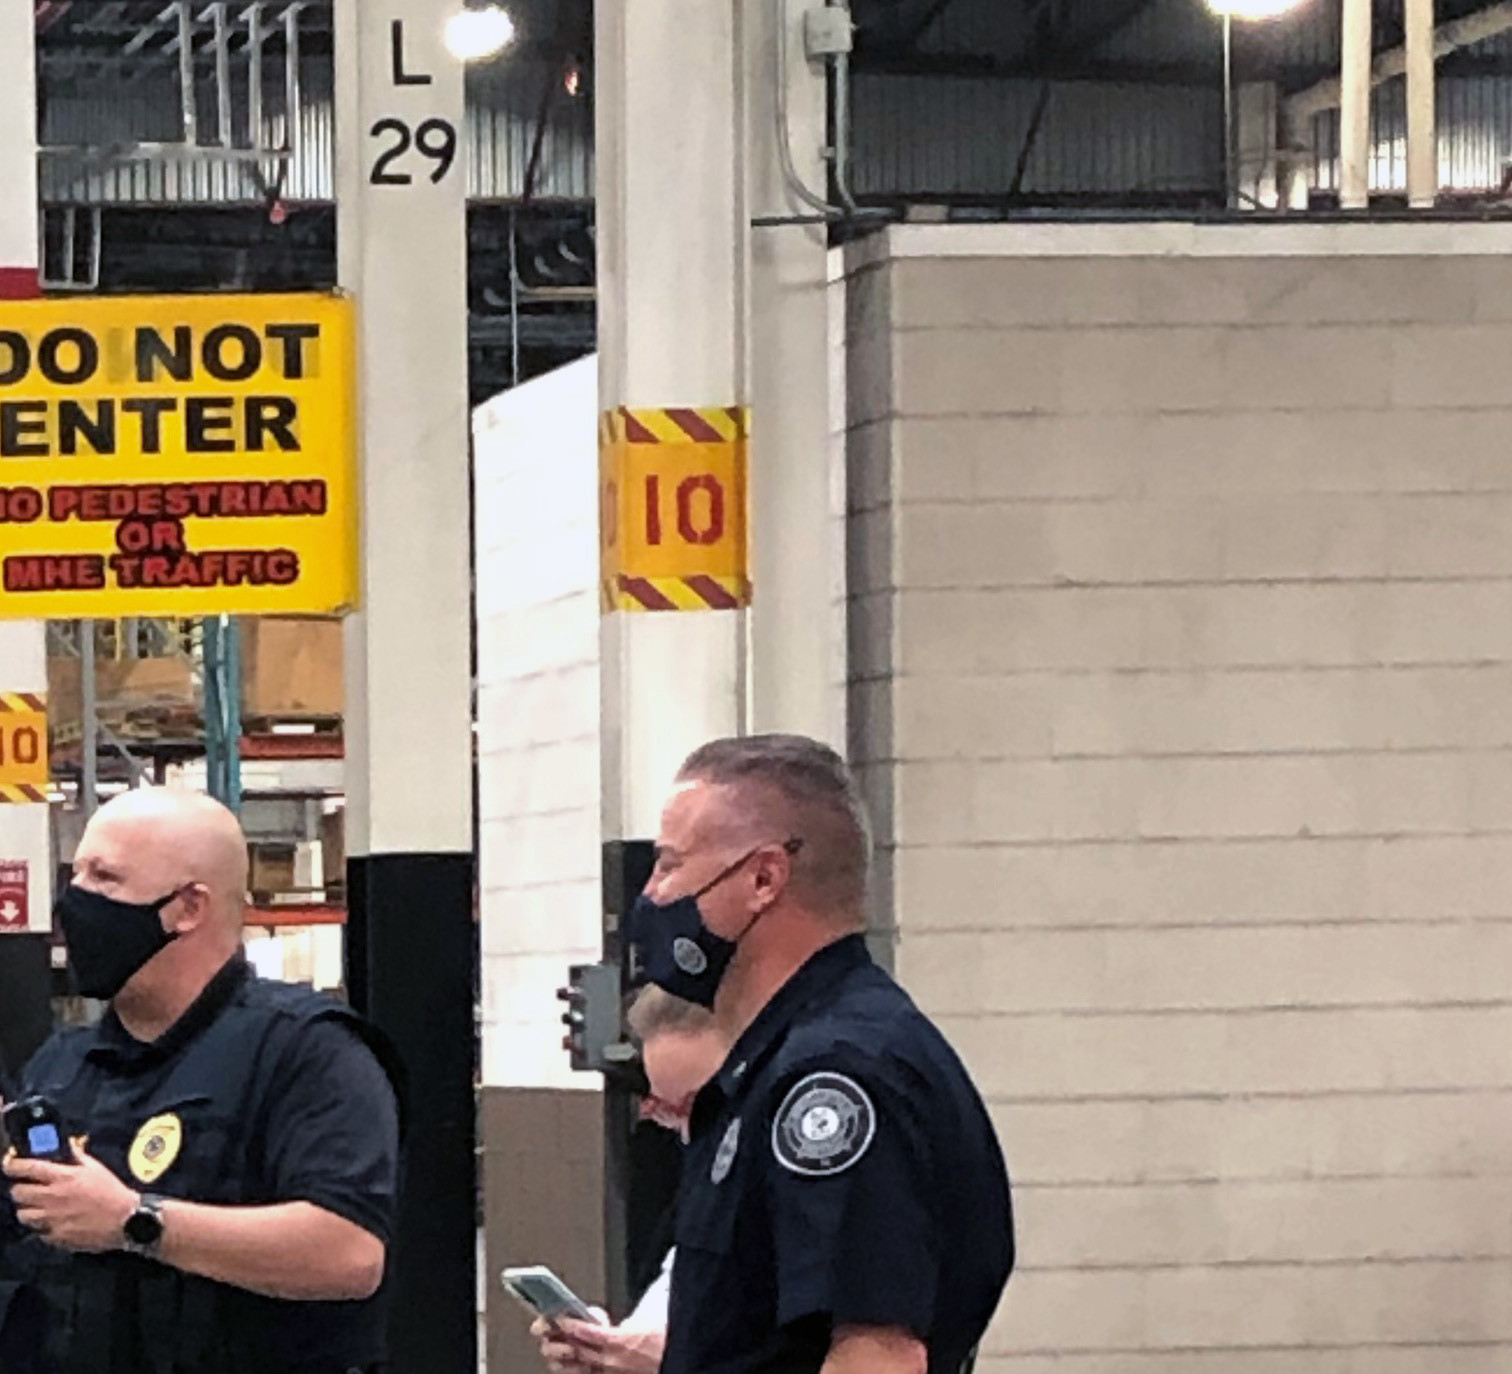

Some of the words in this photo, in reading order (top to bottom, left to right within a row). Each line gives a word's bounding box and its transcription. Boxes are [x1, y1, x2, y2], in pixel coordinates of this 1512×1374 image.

[391, 19, 432, 86] L
[369, 117, 457, 185] 29
[135, 323, 320, 382] NOT
[0, 395, 301, 457] ENTER
[48, 481, 327, 521] PEDESTRIAN
[645, 473, 724, 546] 10
[116, 517, 185, 555] OR
[3, 555, 105, 592] MHE
[112, 549, 299, 587] TRAFFIC
